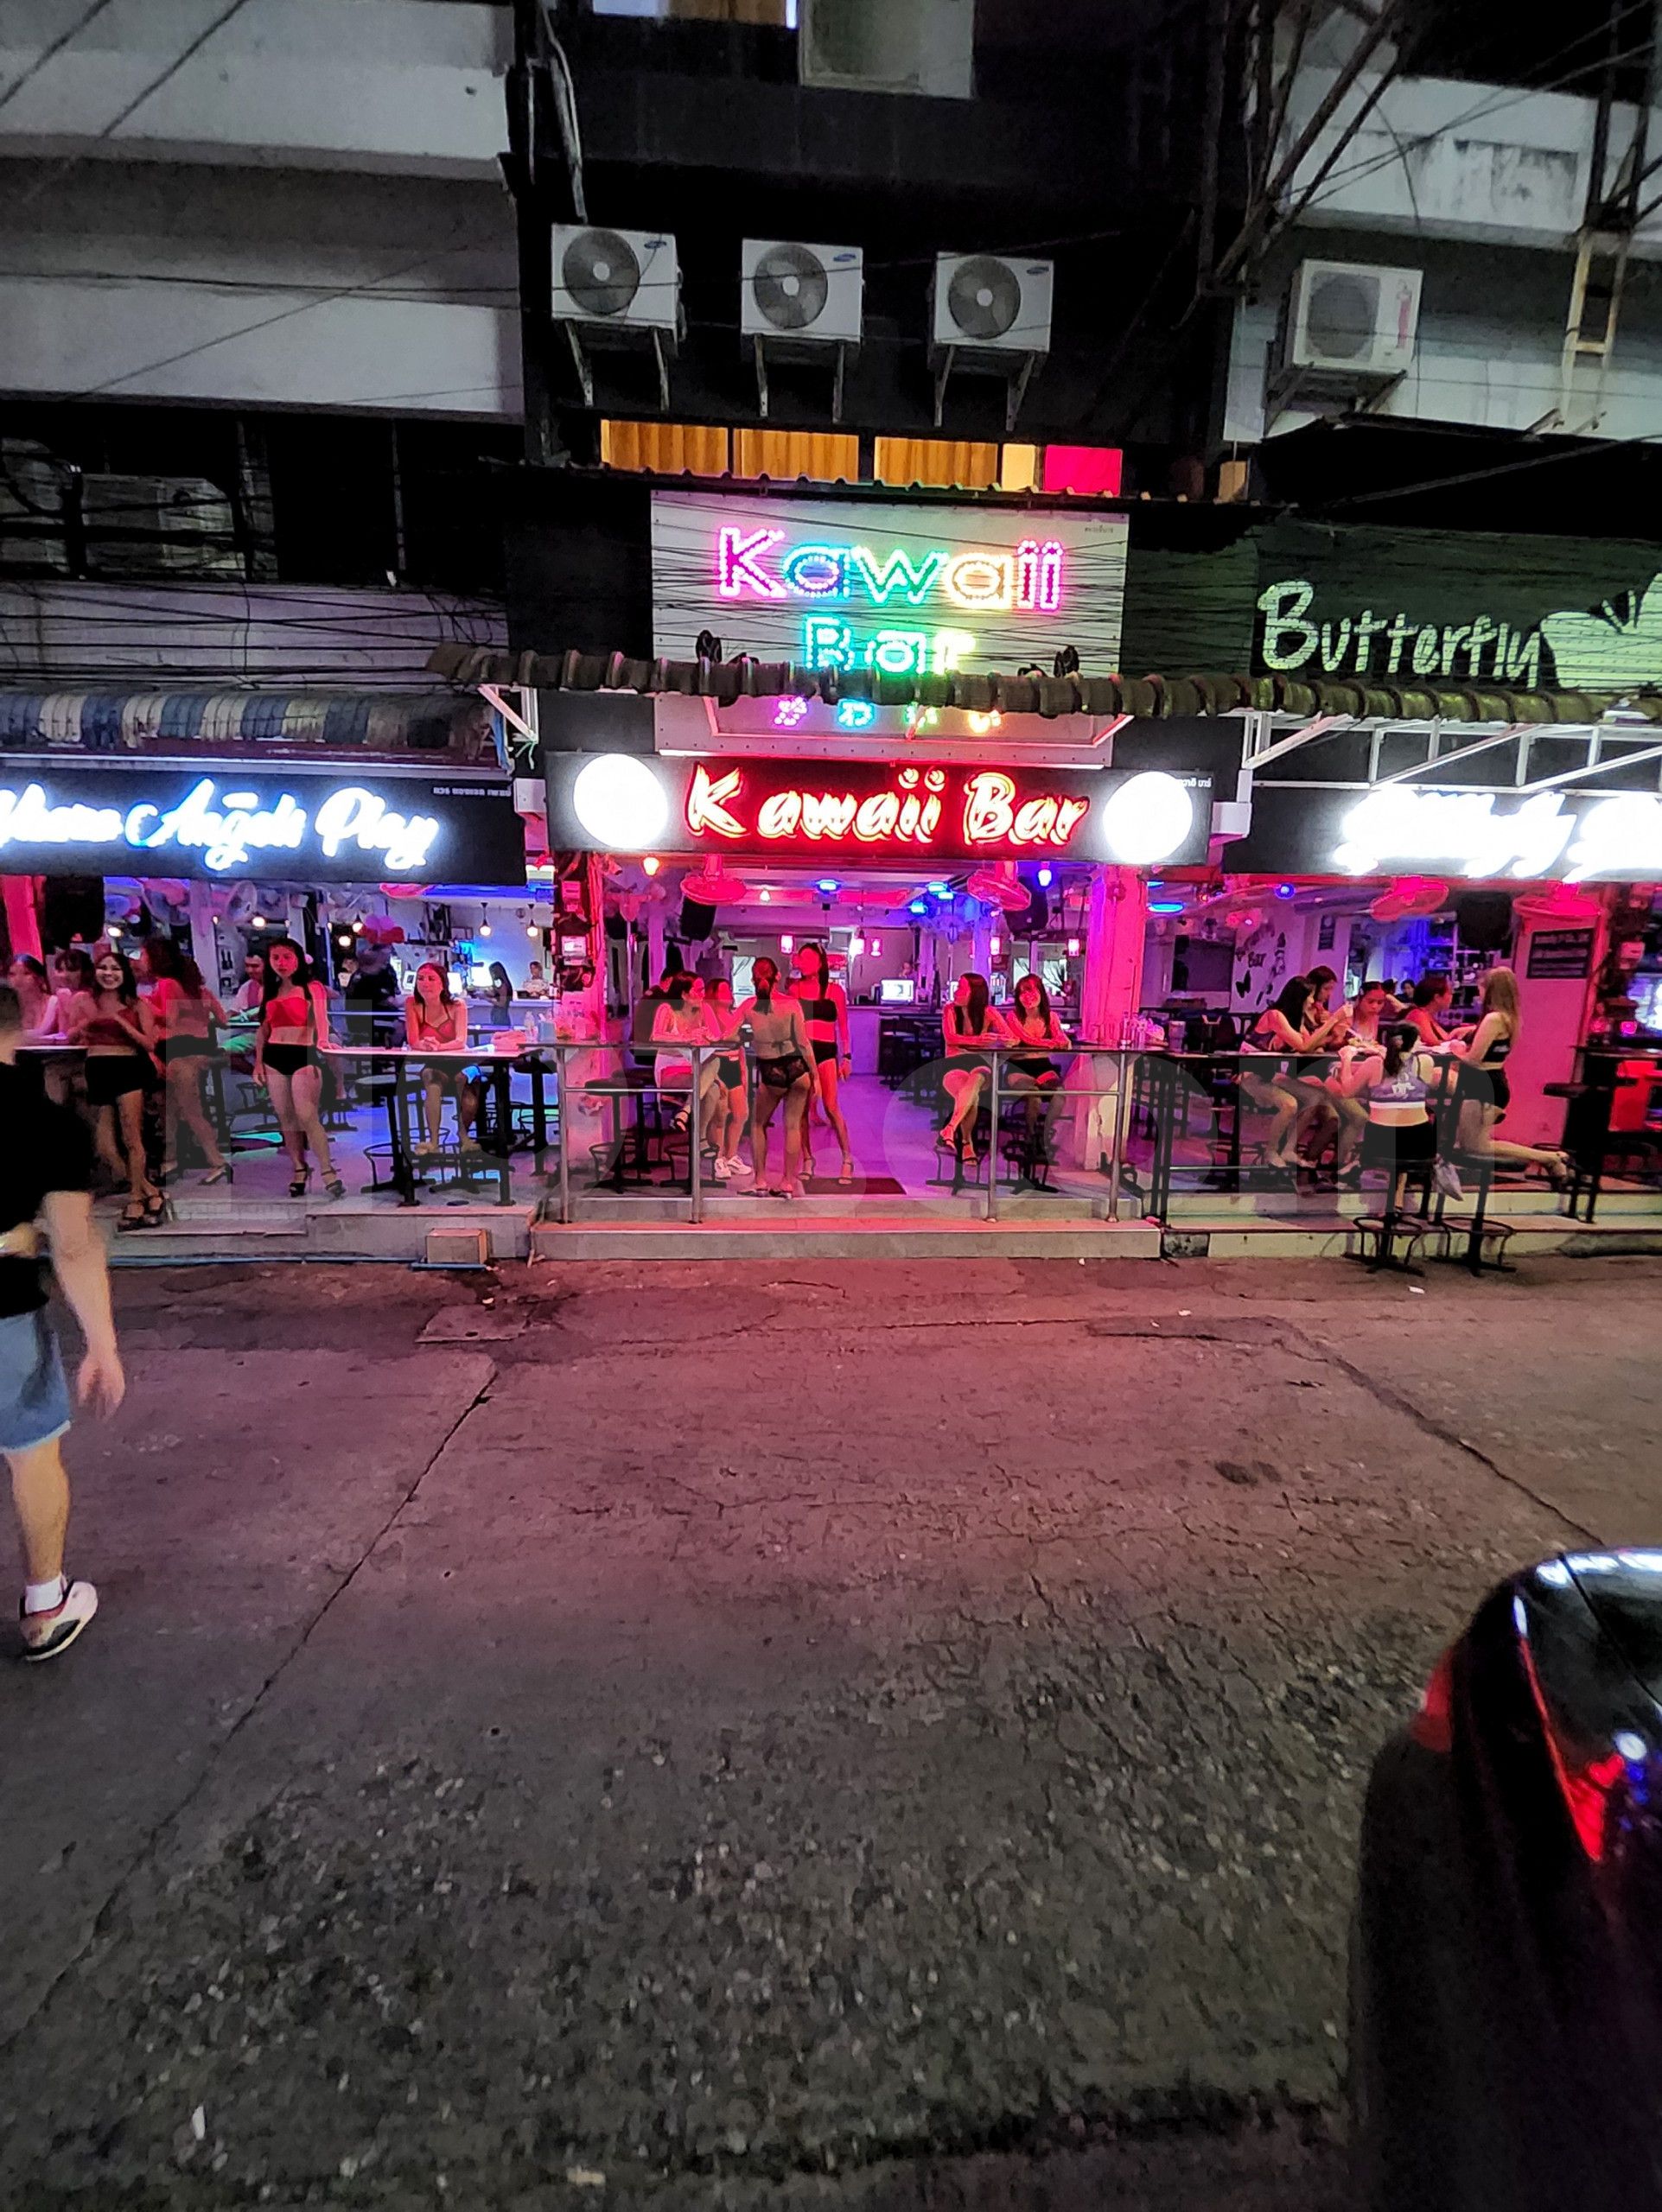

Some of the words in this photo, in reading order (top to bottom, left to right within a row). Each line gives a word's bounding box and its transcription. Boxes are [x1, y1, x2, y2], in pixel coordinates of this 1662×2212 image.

[717, 527, 1066, 610] Kawaii
[805, 616, 976, 675] Bar
[1258, 580, 1542, 690] Butterfly
[687, 764, 945, 844] Kawaii
[964, 772, 1090, 845] Bar
